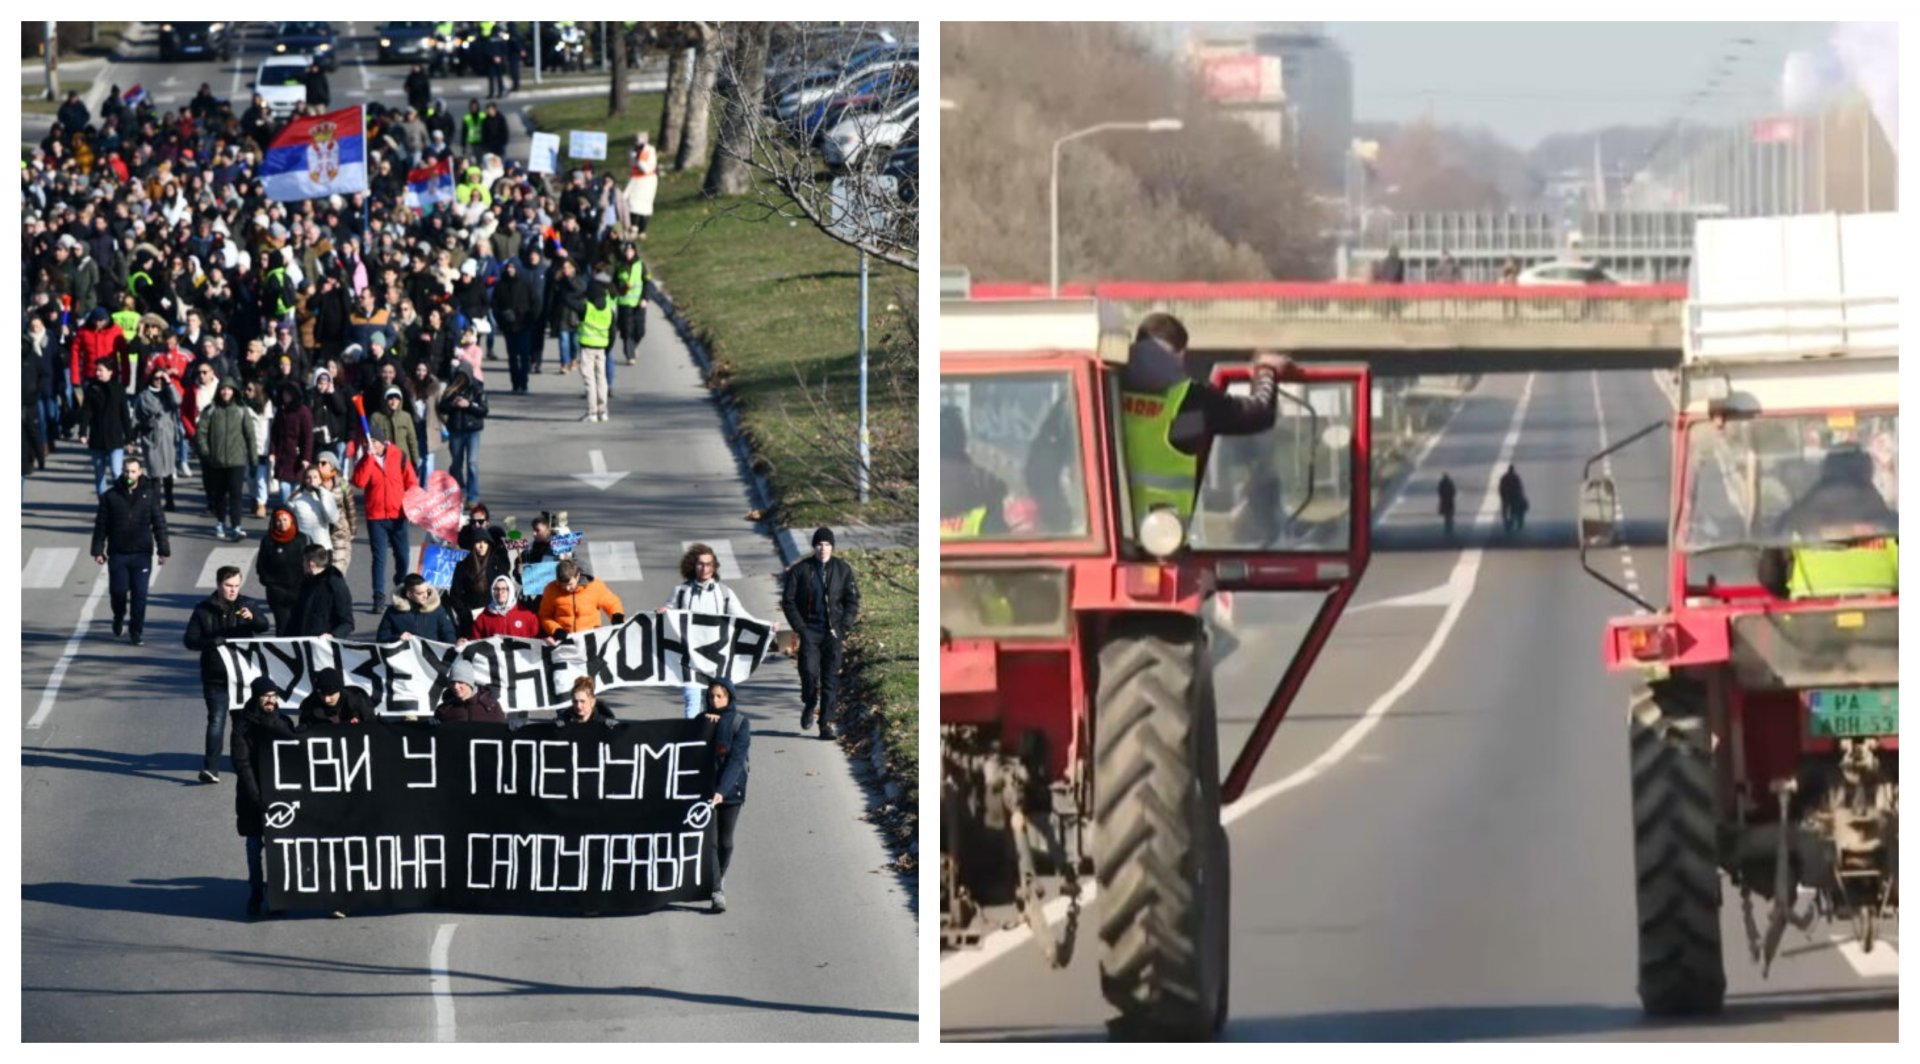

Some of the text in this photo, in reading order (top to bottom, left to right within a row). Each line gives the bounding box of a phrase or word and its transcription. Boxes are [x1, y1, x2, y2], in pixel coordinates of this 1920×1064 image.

[1835, 693, 1860, 710] PA
[273, 734, 707, 800] СВИ У ПЛЕНУМЕ
[273, 830, 704, 892] ТОТАЛНА САМОУПРАВА
